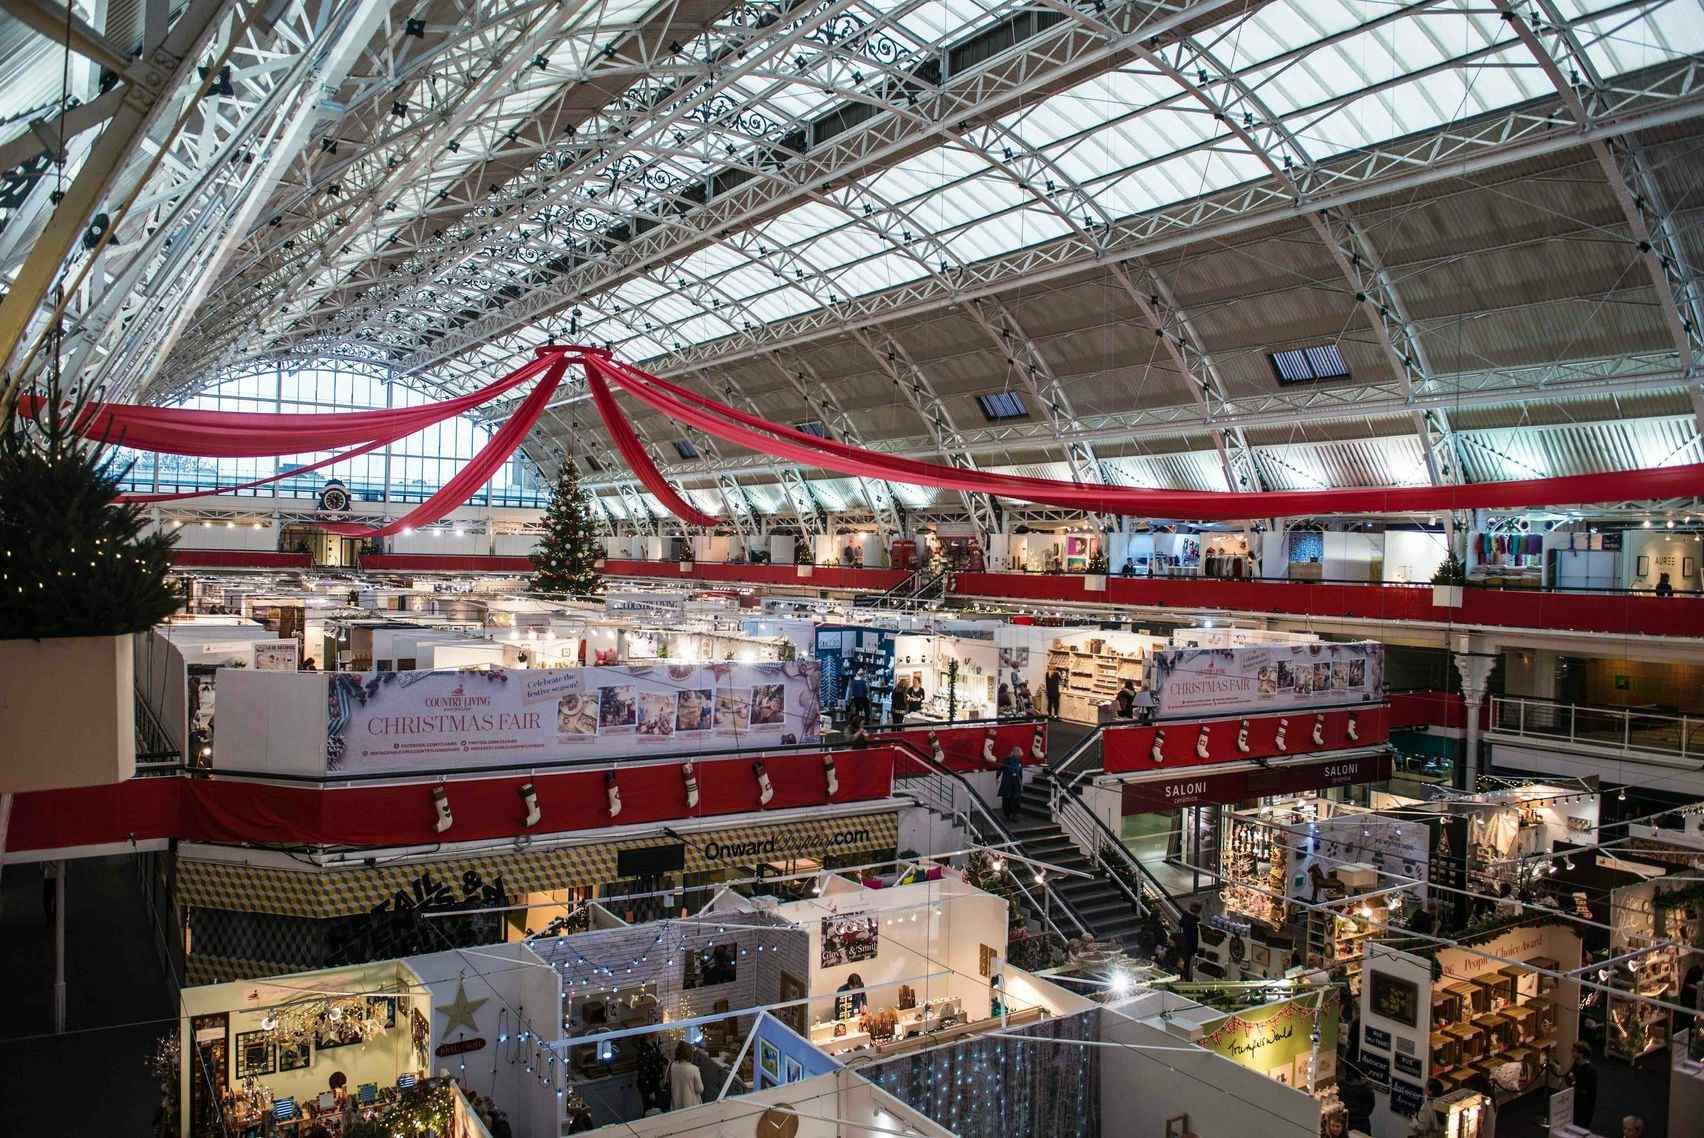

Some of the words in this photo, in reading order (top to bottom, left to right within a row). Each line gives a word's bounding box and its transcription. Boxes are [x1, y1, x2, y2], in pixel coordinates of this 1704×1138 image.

[527, 675, 561, 689] Celebrate
[1169, 679, 1228, 696] CHRISTMAS
[1229, 678, 1251, 691] FAIR
[425, 696, 461, 708] COUNTRY
[463, 695, 490, 707] LIVING
[367, 714, 494, 736] CHRISTMAS
[499, 712, 542, 730] FAIR
[1323, 763, 1359, 777] SALONI
[1164, 781, 1207, 798] SALONI
